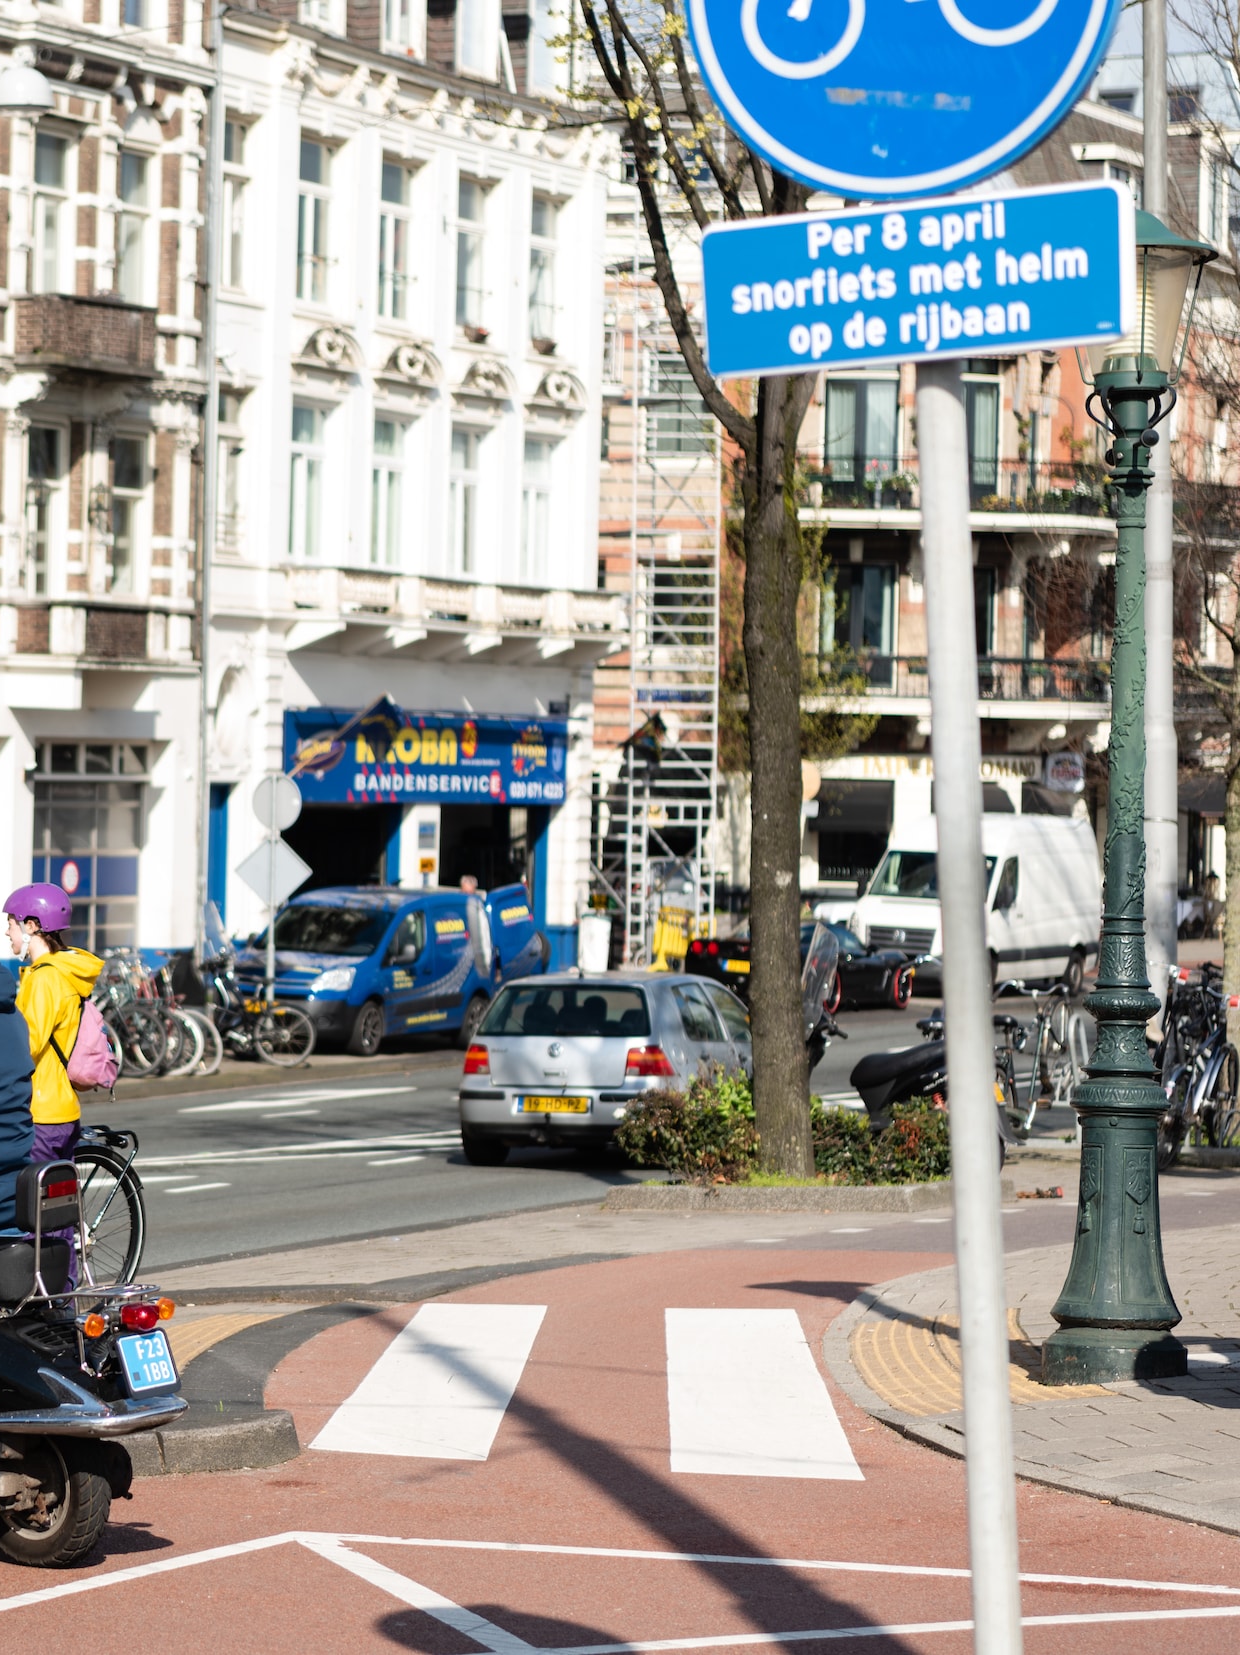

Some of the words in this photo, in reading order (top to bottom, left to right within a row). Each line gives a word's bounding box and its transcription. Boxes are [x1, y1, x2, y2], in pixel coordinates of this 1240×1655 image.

[807, 221, 872, 259] Per
[881, 213, 907, 251] 8
[919, 201, 1006, 251] april
[731, 264, 897, 314] snorfiets
[909, 252, 982, 295] met
[995, 243, 1089, 286] helm
[788, 321, 833, 359] op
[843, 311, 888, 350] de
[899, 300, 1031, 352] rijbaan
[980, 760, 1036, 778] OMANO
[354, 773, 501, 793] BANDENSERVICE
[135, 1338, 165, 1360] F23
[142, 1361, 171, 1383] 1BB
